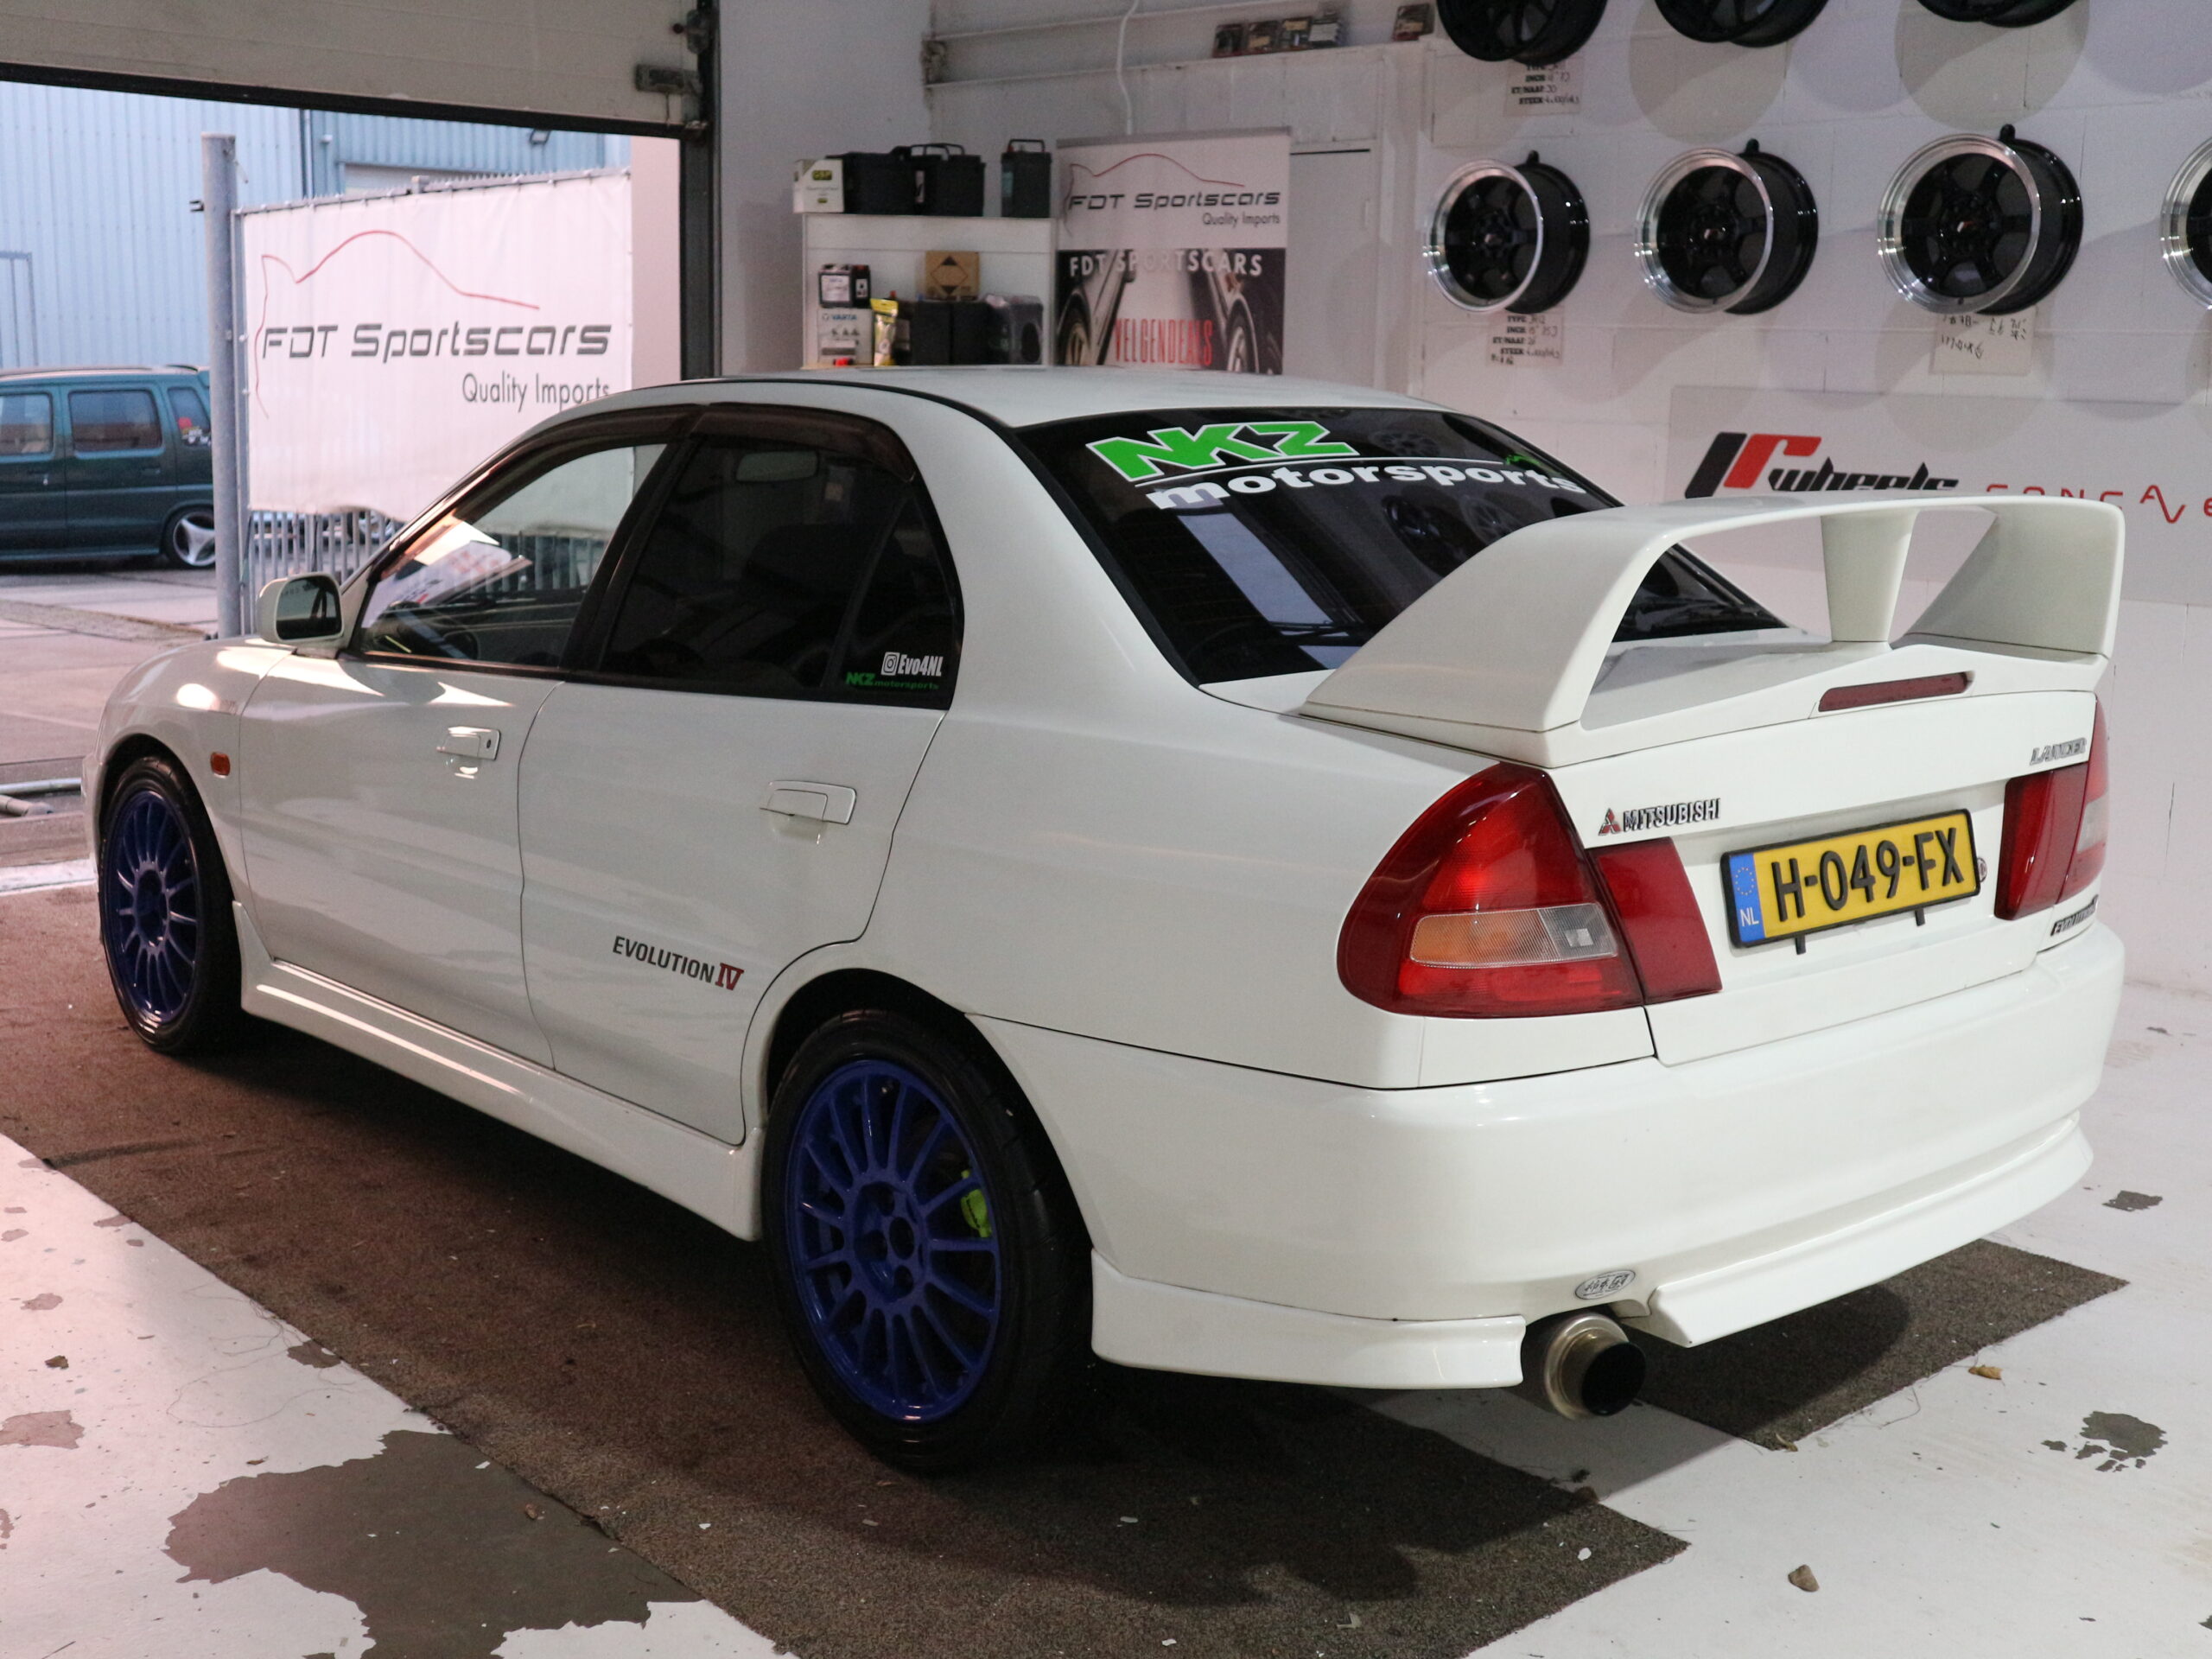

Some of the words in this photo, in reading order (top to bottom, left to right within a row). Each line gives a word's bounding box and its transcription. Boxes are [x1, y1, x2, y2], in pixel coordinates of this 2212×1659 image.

[1069, 194, 1125, 211] FDT
[1134, 191, 1281, 210] Sportscars
[1203, 213, 1238, 227] Quality
[1243, 213, 1281, 227] Imports
[1070, 254, 1107, 276] FDT
[1117, 250, 1263, 276] SPORTSCARS
[262, 324, 339, 359] FDT
[351, 321, 612, 363] Sportscars
[1114, 318, 1214, 366] VELGENDEALS
[462, 370, 528, 412] Quality
[535, 373, 610, 405] Imports
[1085, 421, 1360, 482] NKZ
[1145, 463, 1587, 510] motorsports
[845, 671, 876, 686] NKZ
[874, 679, 939, 690] motorsports
[1623, 798, 1721, 833] MITSUBISHI
[1770, 827, 1964, 923] H-049-FX
[1739, 906, 1760, 928] NL
[612, 935, 715, 983] EVOLUTION
[715, 963, 745, 991] IV
